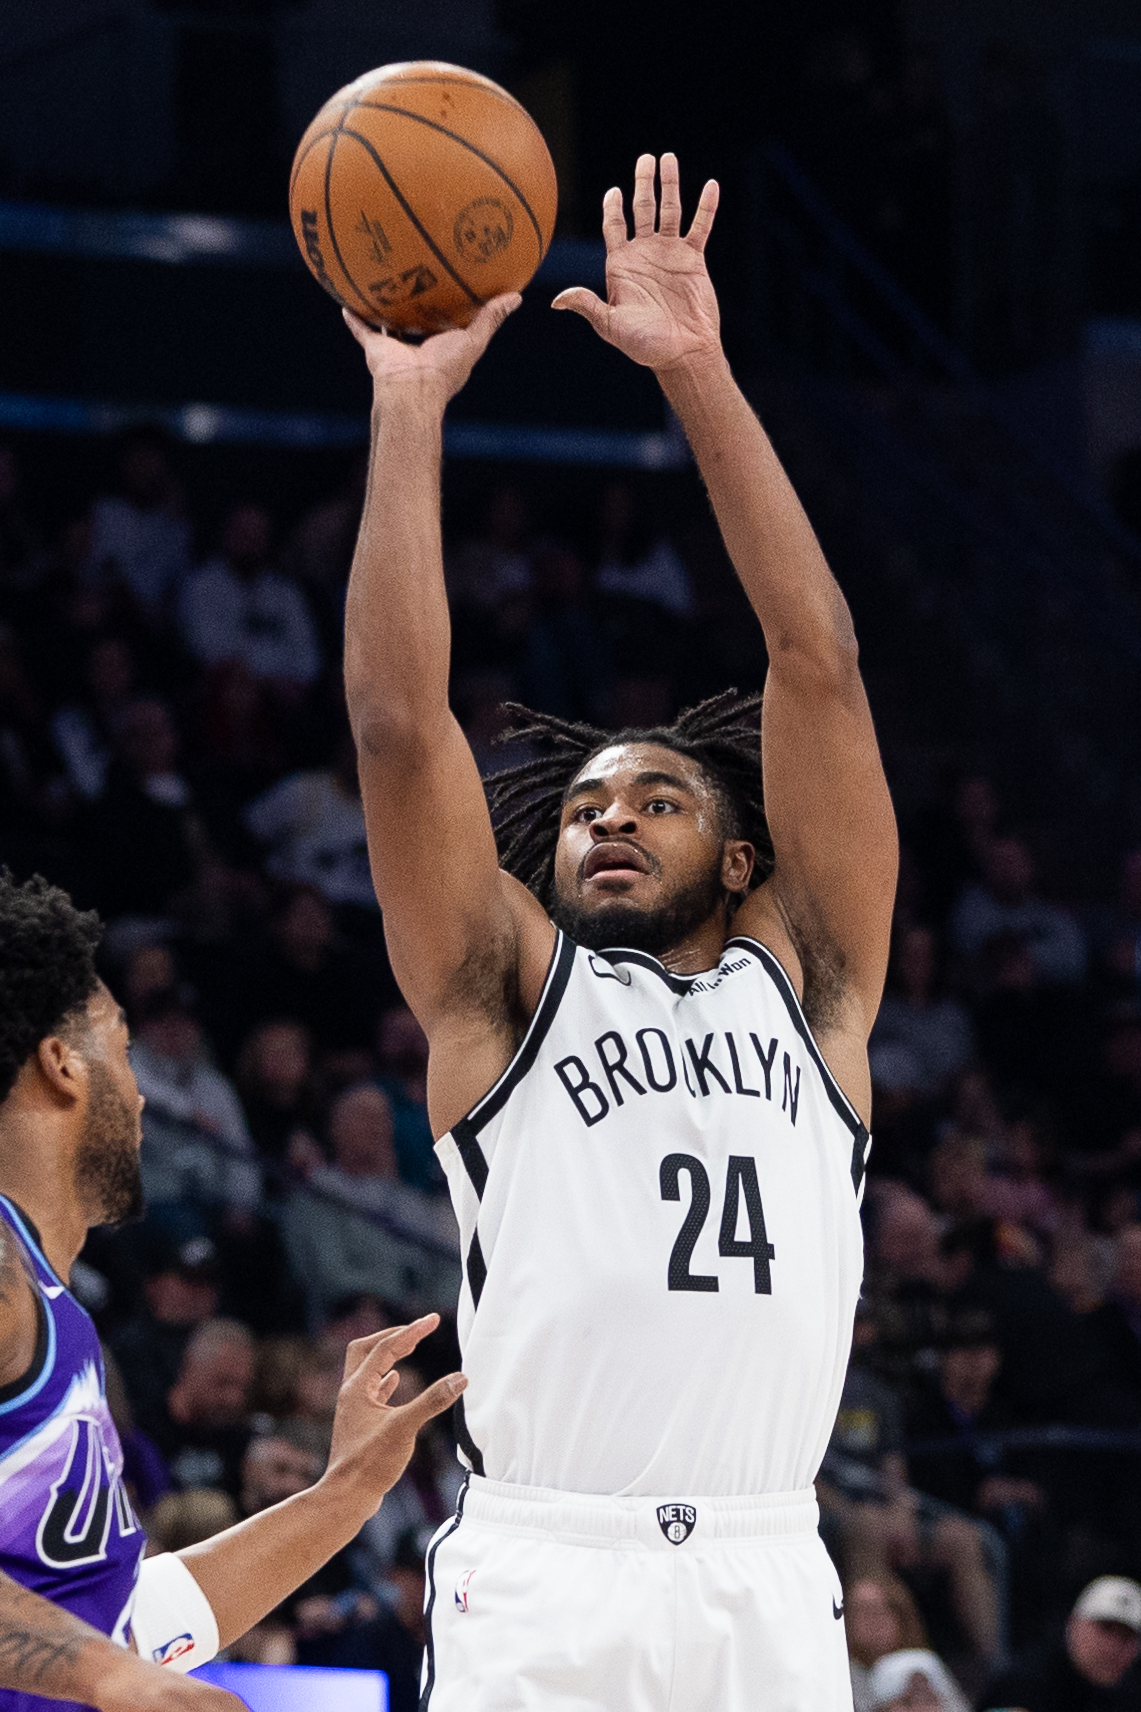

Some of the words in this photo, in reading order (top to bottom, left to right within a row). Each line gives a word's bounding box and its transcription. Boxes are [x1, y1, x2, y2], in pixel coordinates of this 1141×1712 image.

[718, 957, 752, 977] Won
[552, 1027, 802, 1128] BROKLYN
[659, 1153, 776, 1296] 24
[659, 1505, 695, 1524] NETS
